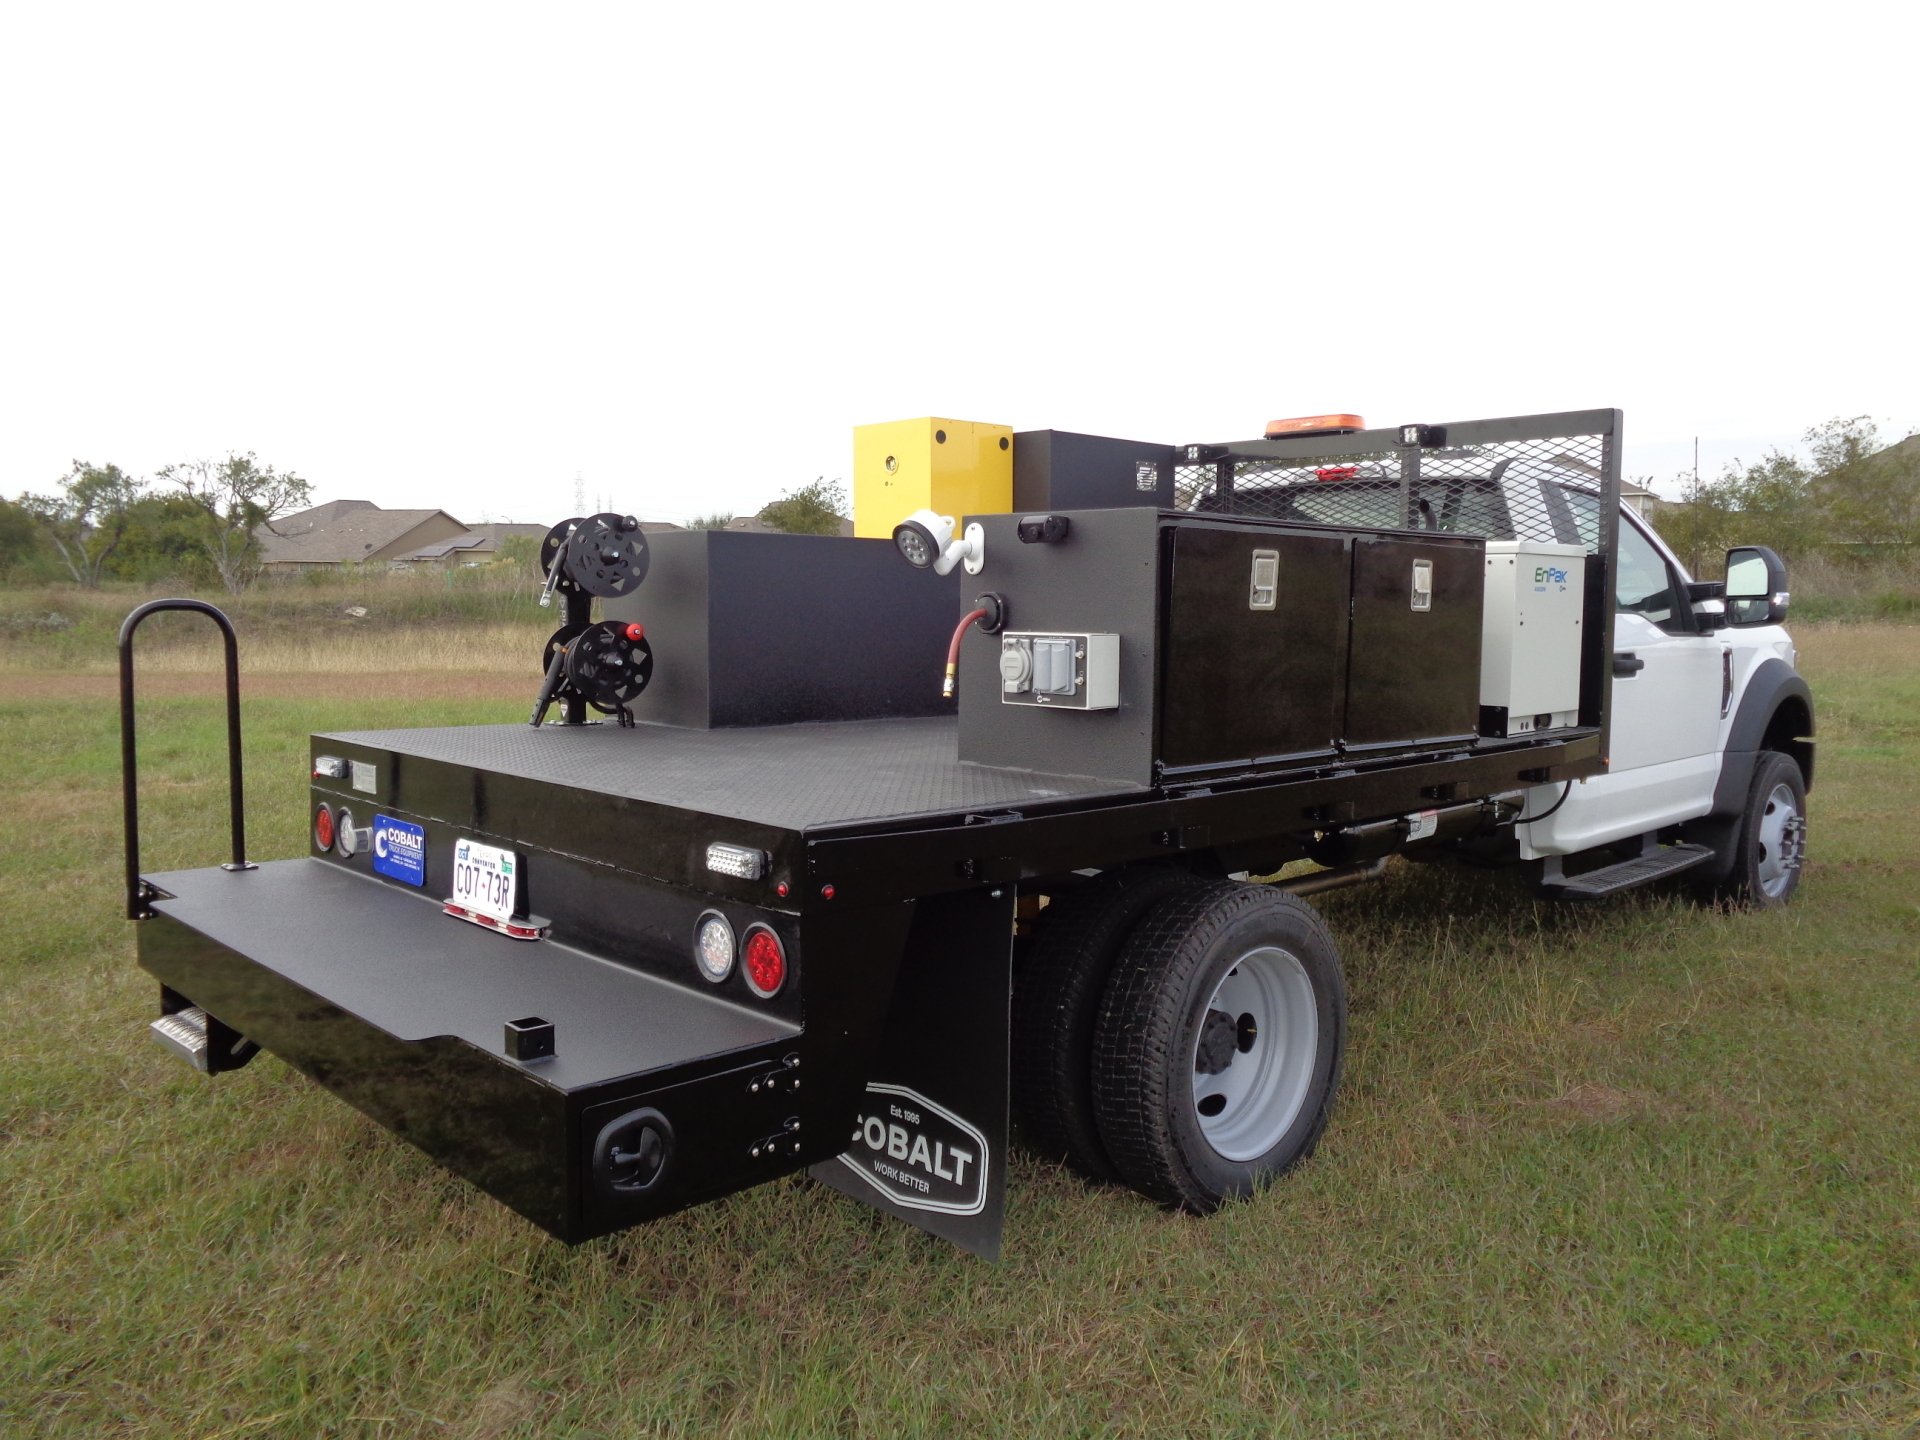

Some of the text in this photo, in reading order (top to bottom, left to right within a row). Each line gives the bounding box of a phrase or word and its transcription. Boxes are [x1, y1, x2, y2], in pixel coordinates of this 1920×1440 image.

[1535, 567, 1568, 583] EnPak
[388, 827, 422, 850] COBALT
[388, 844, 400, 855] TRUCK
[400, 848, 422, 861] EQUIPMENT
[874, 1160, 930, 1195] WORK BETTER
